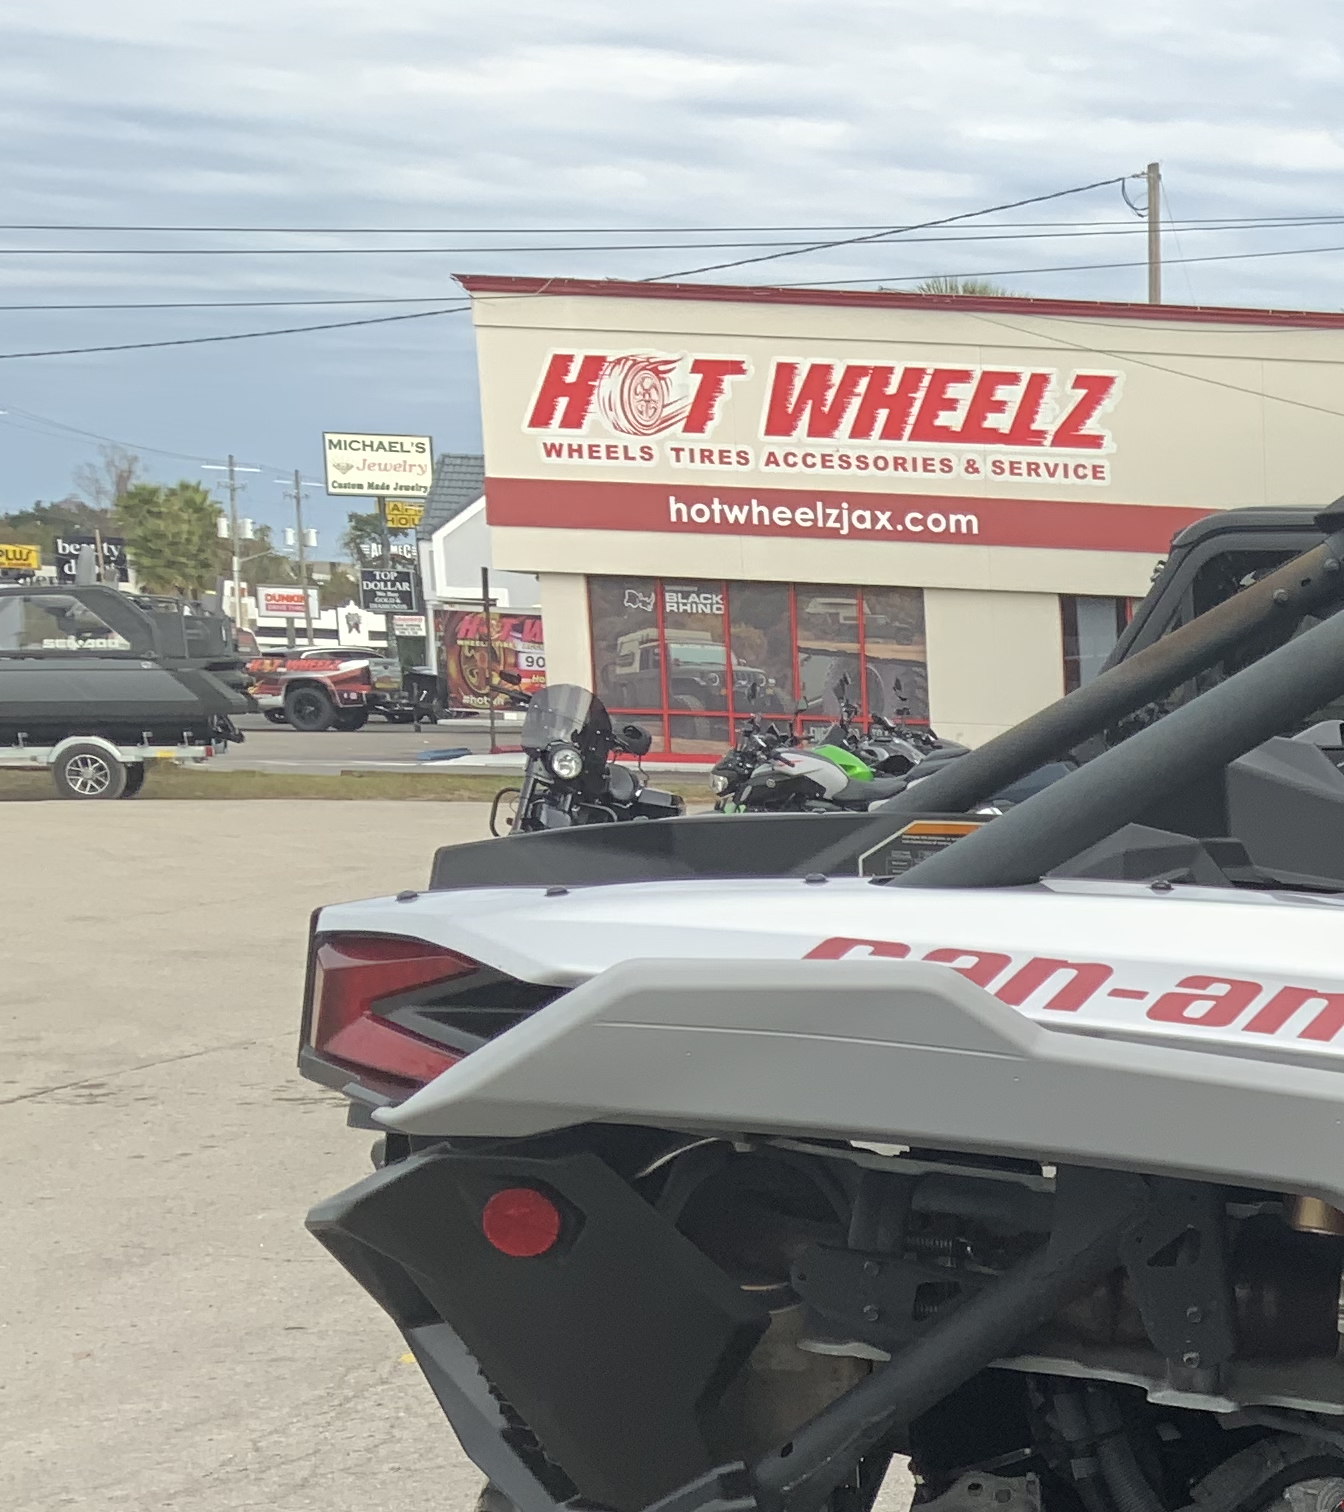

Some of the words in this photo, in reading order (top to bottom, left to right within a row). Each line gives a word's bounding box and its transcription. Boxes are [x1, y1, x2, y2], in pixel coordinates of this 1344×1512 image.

[527, 353, 748, 437] HOT
[763, 361, 1116, 450] WHEELZ
[327, 439, 427, 454] MICHAEL'S
[356, 458, 428, 476] Jewelry
[542, 442, 655, 463] WHEELS
[671, 448, 750, 467] TIRES
[764, 453, 954, 475] ACCESSORIES
[964, 458, 981, 476] &
[991, 458, 1107, 482] SERVICE
[331, 480, 364, 490] Custom
[367, 481, 390, 491] Made
[393, 482, 428, 493] Jewelry
[668, 496, 980, 535] hotwheelzjax.com
[373, 571, 397, 580] TOP
[363, 580, 410, 591] DOLLAR
[665, 592, 723, 604] BLACK
[665, 603, 725, 615] RHINO
